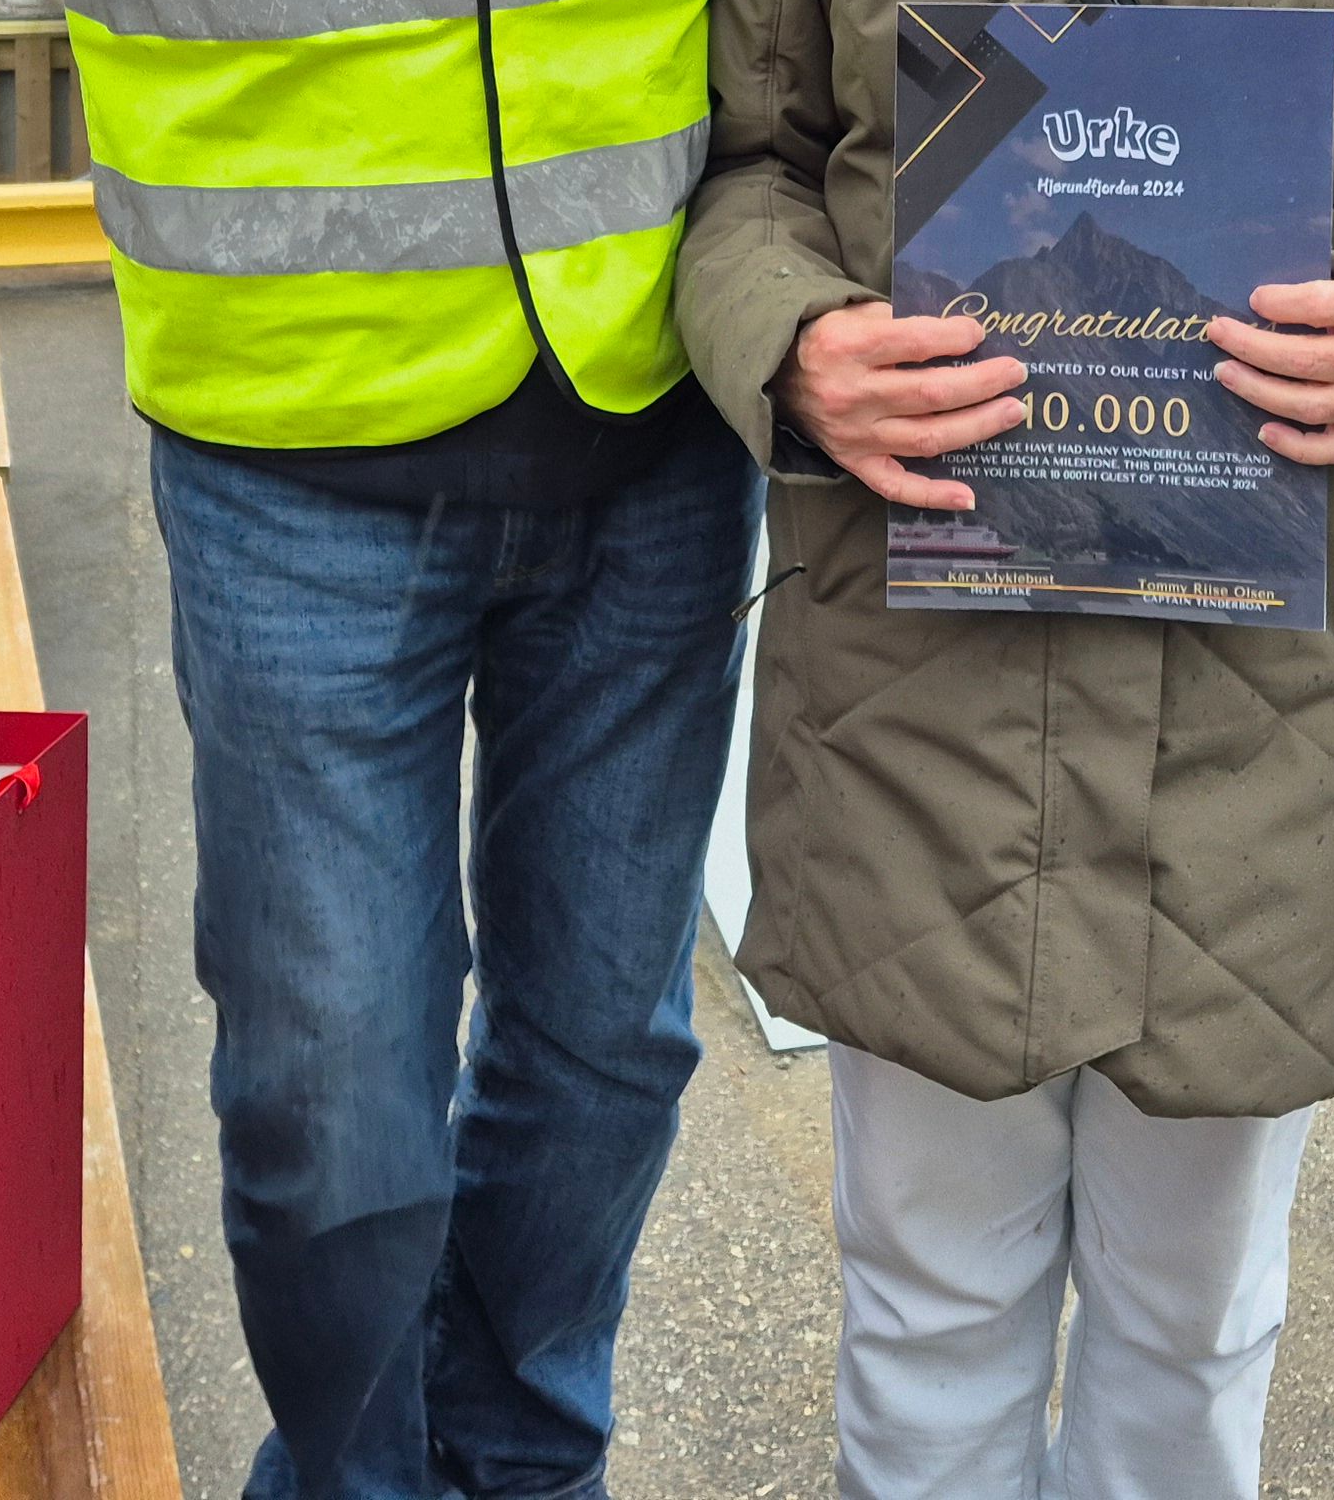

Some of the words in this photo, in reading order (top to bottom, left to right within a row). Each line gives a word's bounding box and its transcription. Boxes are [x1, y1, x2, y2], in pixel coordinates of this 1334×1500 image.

[1042, 106, 1180, 166] Urke
[1037, 177, 1139, 198] Hjørundfjorden
[1142, 180, 1185, 197] 2024
[1087, 364, 1106, 376] TO
[1110, 365, 1139, 378] OUR
[1144, 366, 1188, 380] GUEST
[1022, 391, 1191, 437] 10.000
[974, 442, 1001, 452] YEAR
[1004, 442, 1022, 453] WE
[1025, 443, 1054, 454] HAVE
[1058, 443, 1082, 454] HAD
[1085, 444, 1119, 456] MANY
[1122, 446, 1192, 460] WONDERFUL
[1245, 453, 1271, 465] AND
[941, 454, 978, 464] TODAY
[980, 455, 998, 465] WE
[1001, 455, 1038, 466] REACH
[1041, 456, 1050, 466] A
[1124, 460, 1150, 471] THIS
[1154, 461, 1206, 474] DIPLOMA
[1209, 464, 1220, 475] IS
[1223, 465, 1232, 476] A
[1235, 466, 1273, 478] PROOF
[951, 467, 980, 477] THAT
[983, 468, 1006, 478] YOU
[1010, 468, 1020, 478] IS
[1023, 468, 1047, 479] OUR
[1050, 469, 1060, 479] 10
[1063, 470, 1097, 481] 000TH
[1100, 472, 1136, 483] GUEST
[1139, 474, 1156, 484] OF
[1158, 475, 1181, 486] THE
[1184, 476, 1229, 488] SEASON
[985, 571, 1055, 586] Myklebust
[1138, 578, 1188, 593] Tommy
[1193, 582, 1228, 597] Riise
[1234, 586, 1275, 600] Olsen
[970, 586, 1000, 596] HOST
[1004, 587, 1032, 596] URKE
[1143, 595, 1192, 606] CAPTAIN
[1196, 598, 1269, 612] TENDERBOAT
